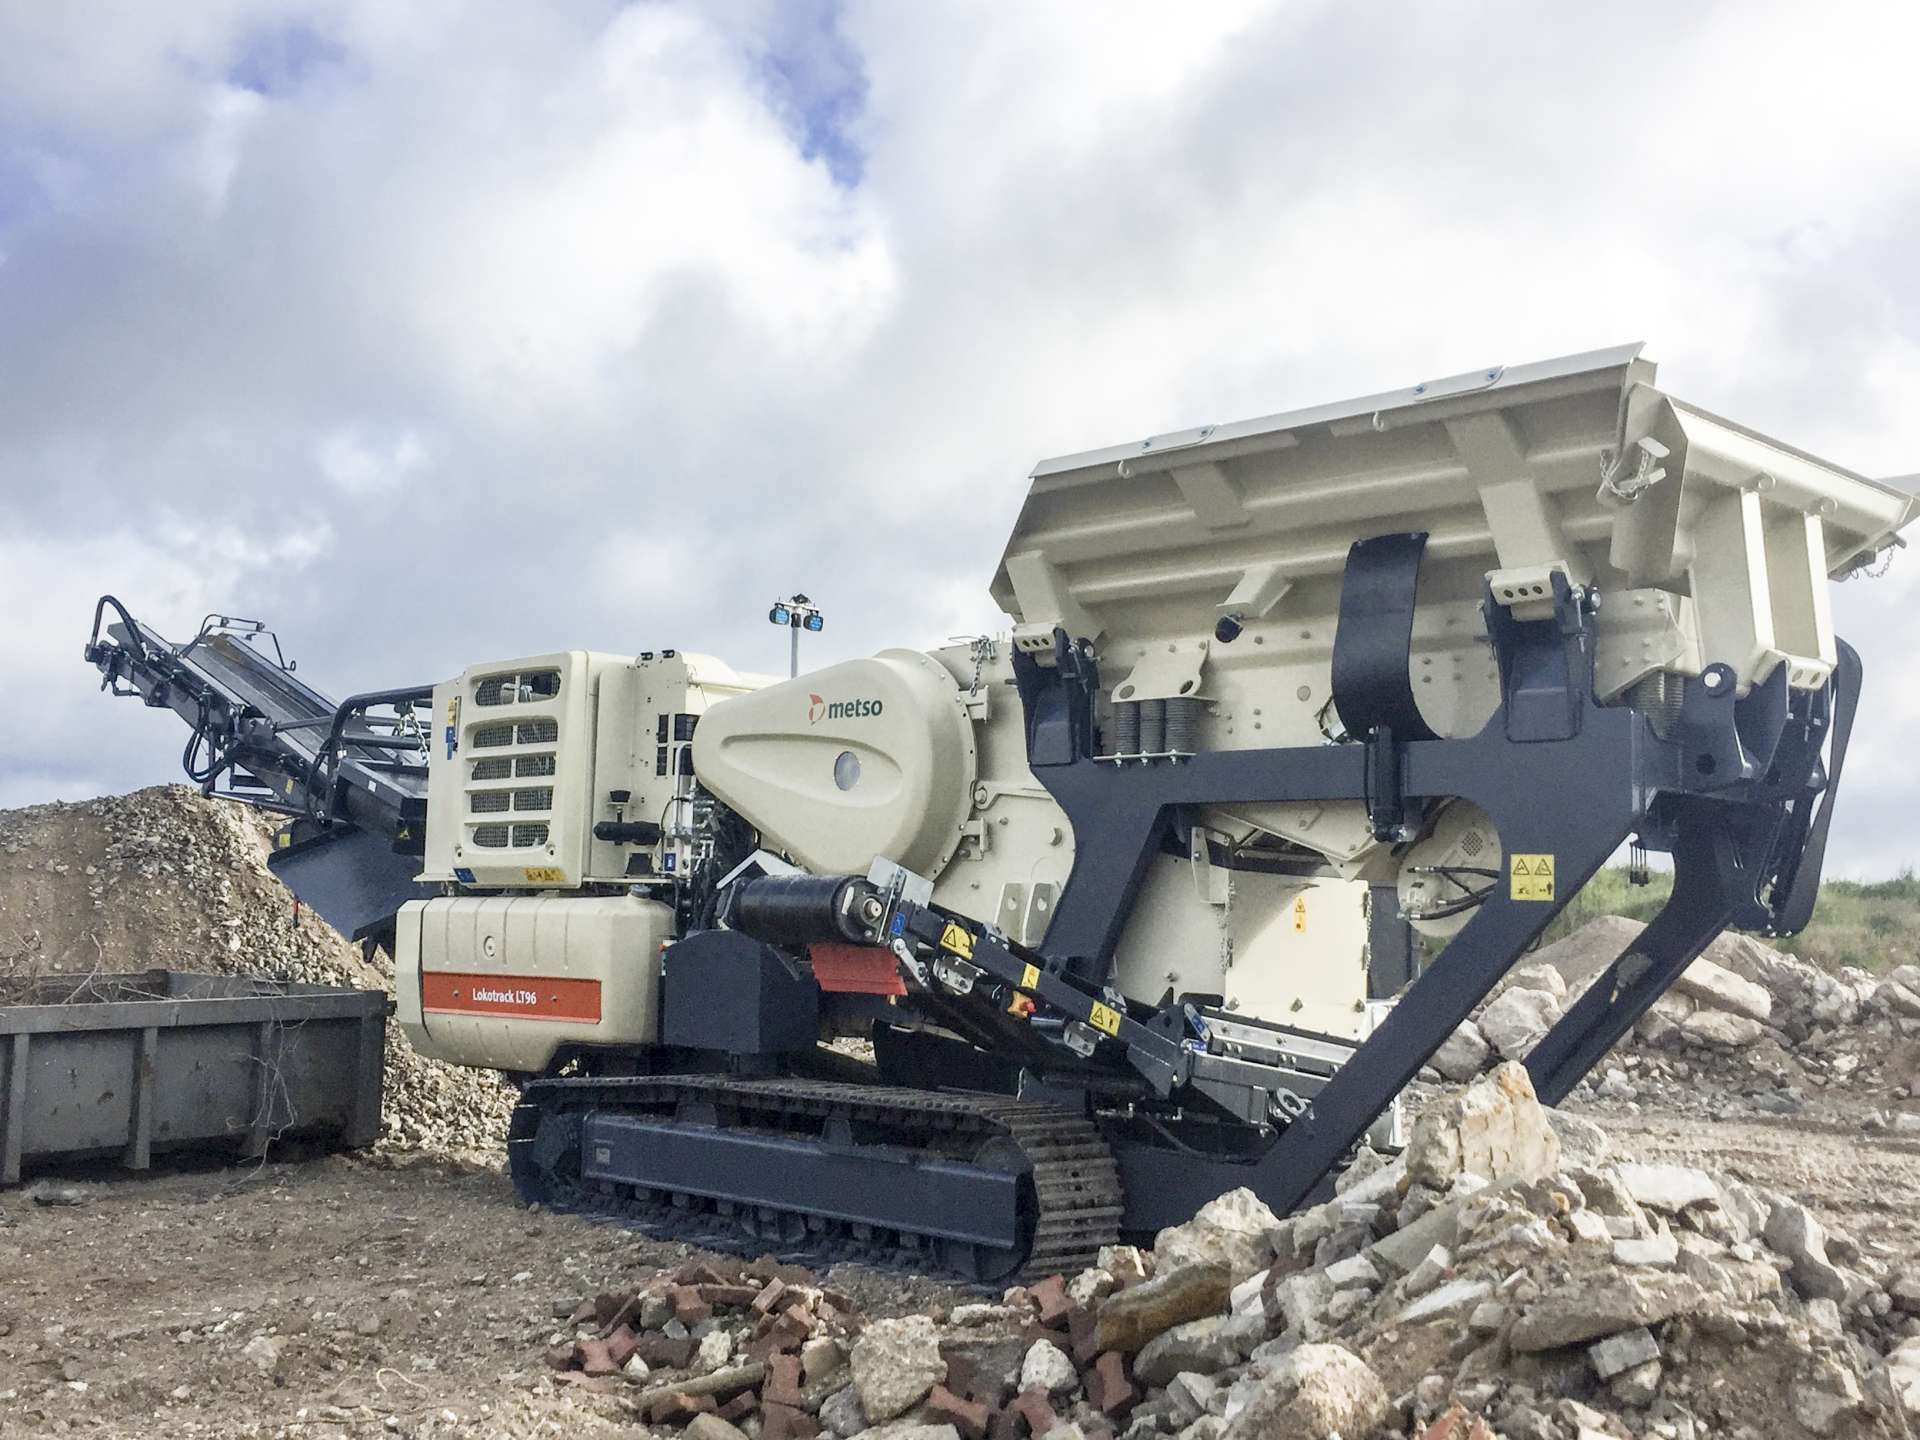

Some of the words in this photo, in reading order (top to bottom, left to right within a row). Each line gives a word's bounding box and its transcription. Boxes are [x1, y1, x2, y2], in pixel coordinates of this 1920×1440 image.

[828, 698, 883, 719] metso
[472, 987, 515, 1003] Lokotrack
[515, 990, 537, 1005] LT96
